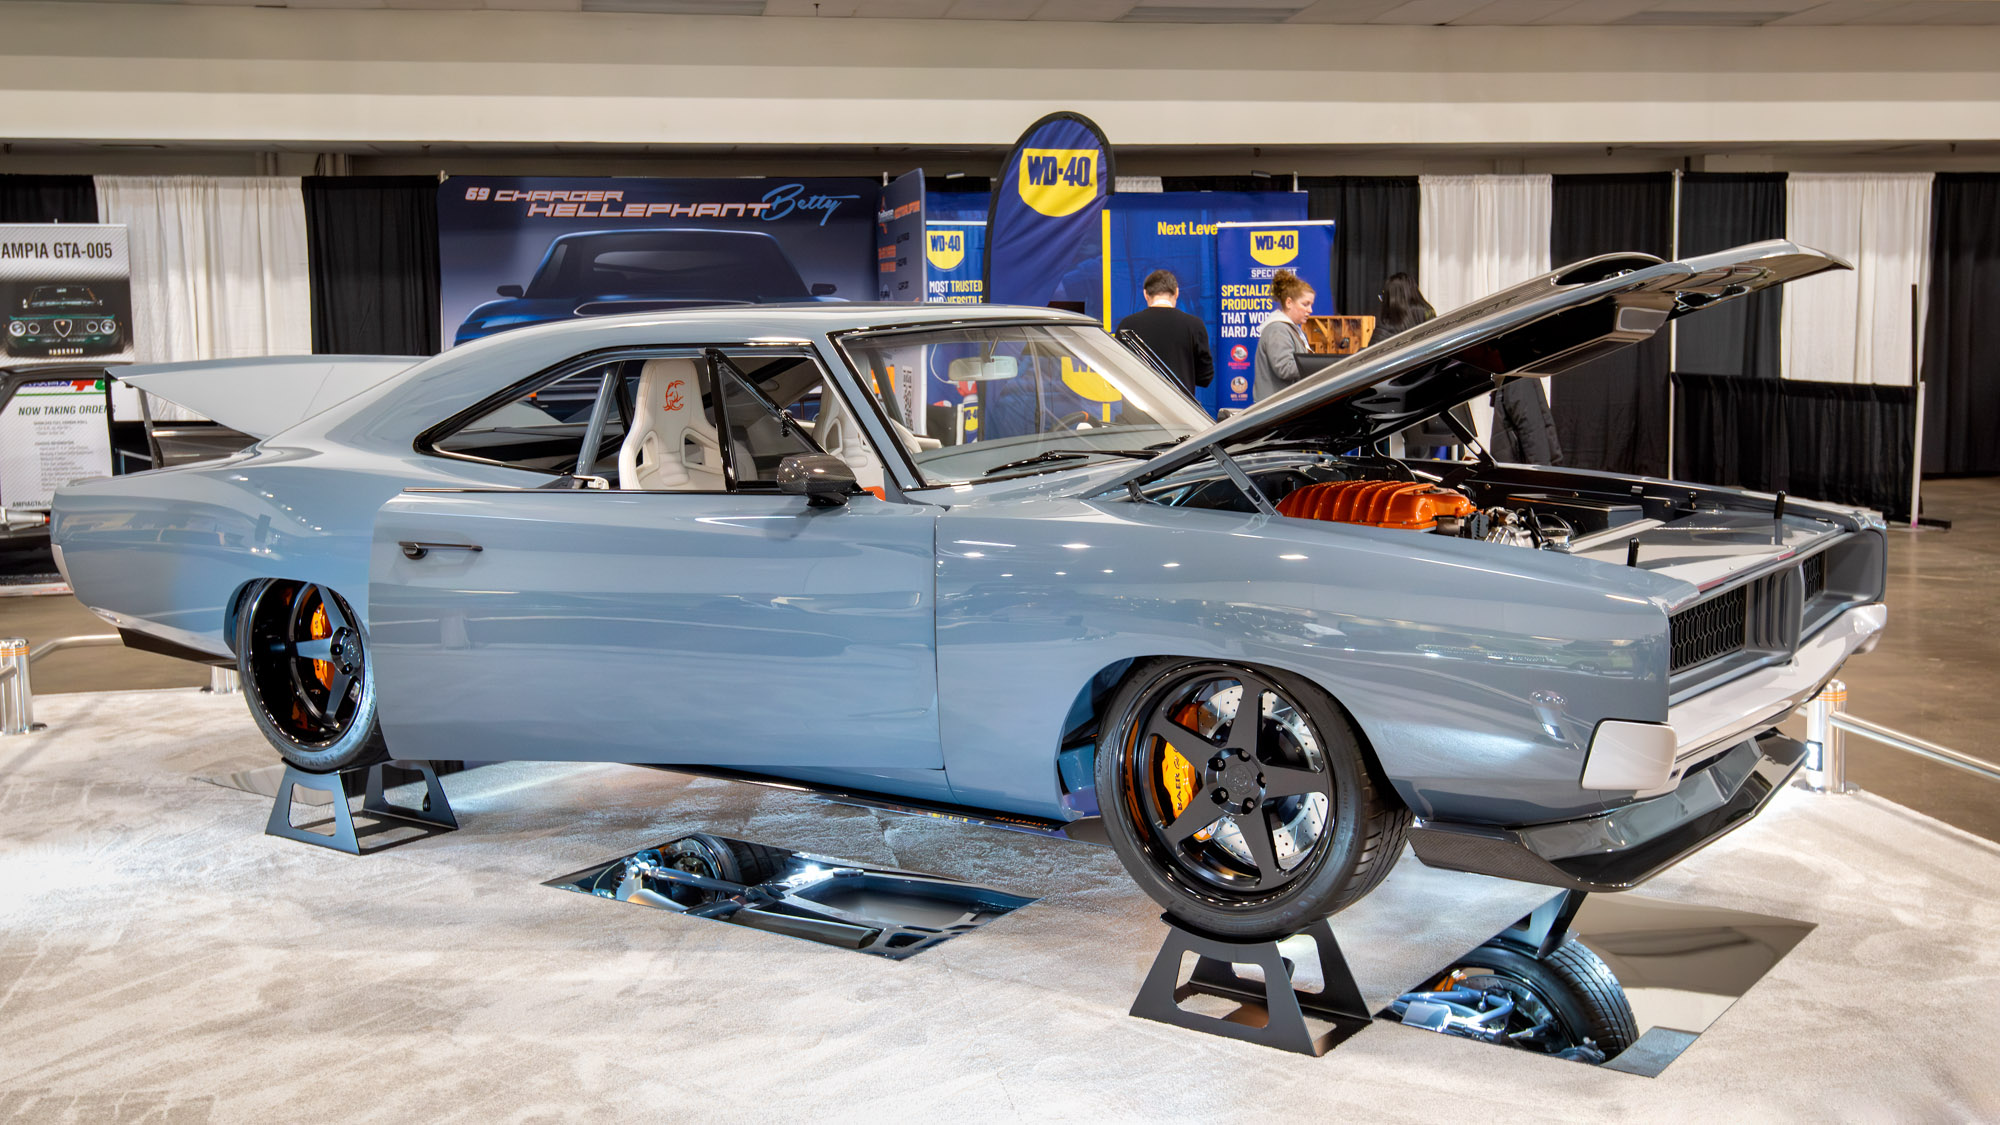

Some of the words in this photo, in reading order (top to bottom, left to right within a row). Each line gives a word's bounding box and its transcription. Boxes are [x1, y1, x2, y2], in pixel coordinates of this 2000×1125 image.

[1027, 155, 1092, 187] WD-40
[465, 187, 491, 201] 69
[494, 190, 625, 202] CHARGER
[527, 203, 772, 218] HELLEPHANT
[761, 183, 861, 227] Betty
[1157, 221, 1187, 236] Next
[1189, 221, 1221, 236] Leve
[930, 234, 961, 252] WD-40
[1255, 234, 1295, 251] WD-40
[1, 242, 49, 259] AMPIA
[53, 242, 113, 259] GTA-005
[929, 281, 949, 293] MOST
[950, 280, 984, 293] TRUSTED
[1221, 284, 1275, 297] SPECIALIZ
[1221, 298, 1273, 311] PRODUCTS
[1221, 312, 1246, 324] THAT
[1221, 326, 1248, 338] HARD
[18, 406, 42, 416] NOW
[44, 405, 76, 416] TAKING
[1174, 772, 1183, 811] BAER
